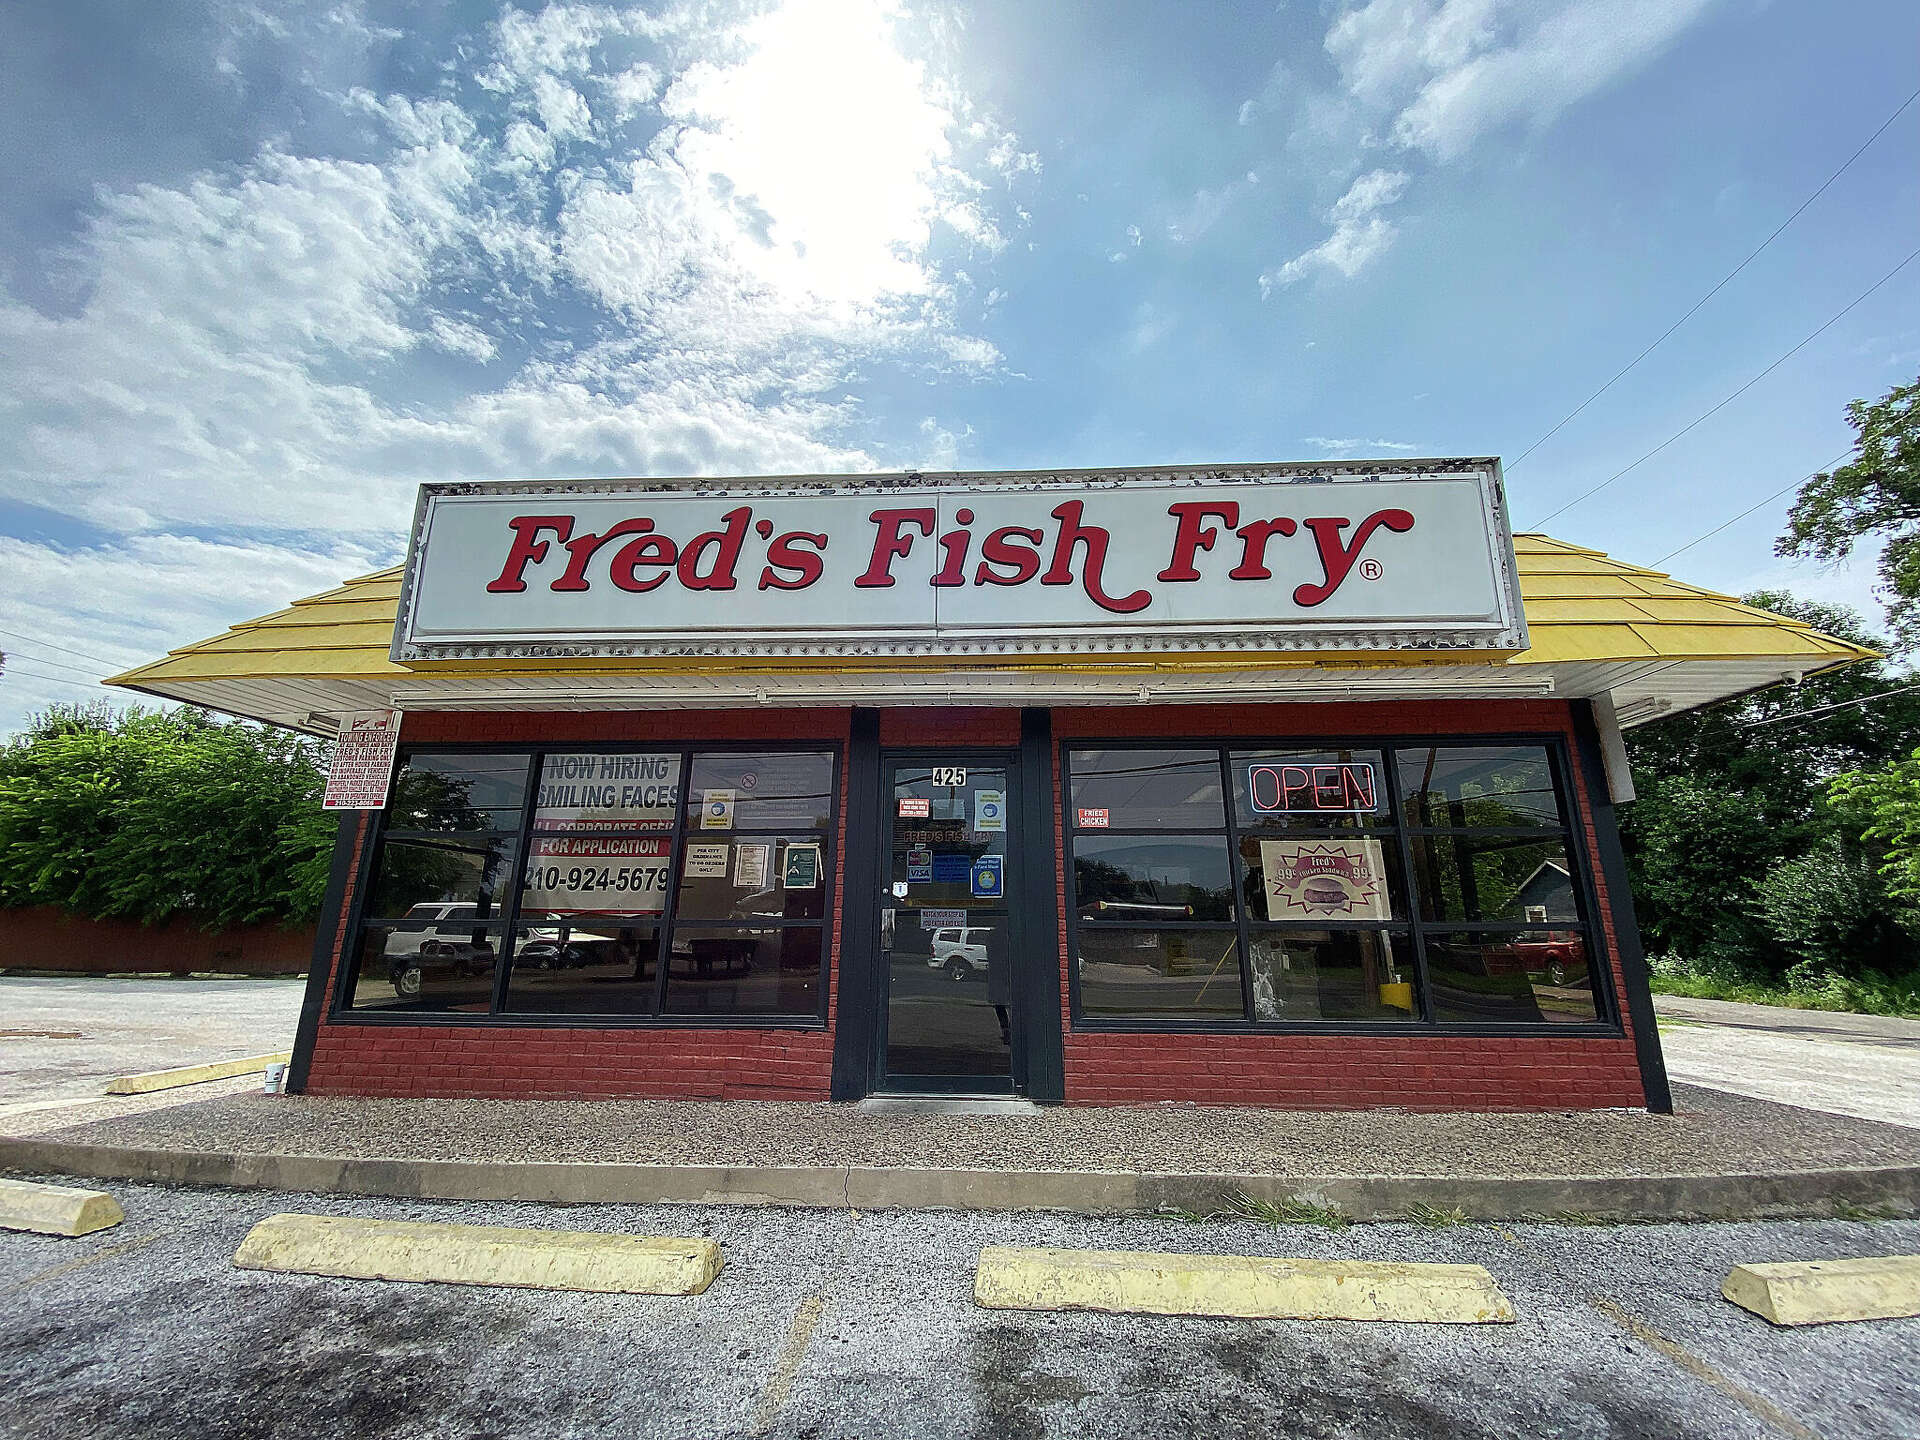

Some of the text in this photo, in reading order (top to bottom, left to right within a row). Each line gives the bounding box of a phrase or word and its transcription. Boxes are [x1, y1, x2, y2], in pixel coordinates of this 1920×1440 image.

[486, 507, 827, 592] Fred's
[854, 499, 1152, 614] Fish
[1158, 500, 1416, 608] Fry
[549, 755, 669, 780] NOW HIRING
[933, 768, 966, 786] 425
[537, 784, 678, 809] SMILING FACES
[1252, 766, 1374, 809] OPEN
[1081, 817, 1108, 825] CHICKEN
[540, 839, 659, 854] FOR APPLICATION
[1311, 856, 1336, 866] Fred's
[524, 866, 669, 892] 210-924-5679
